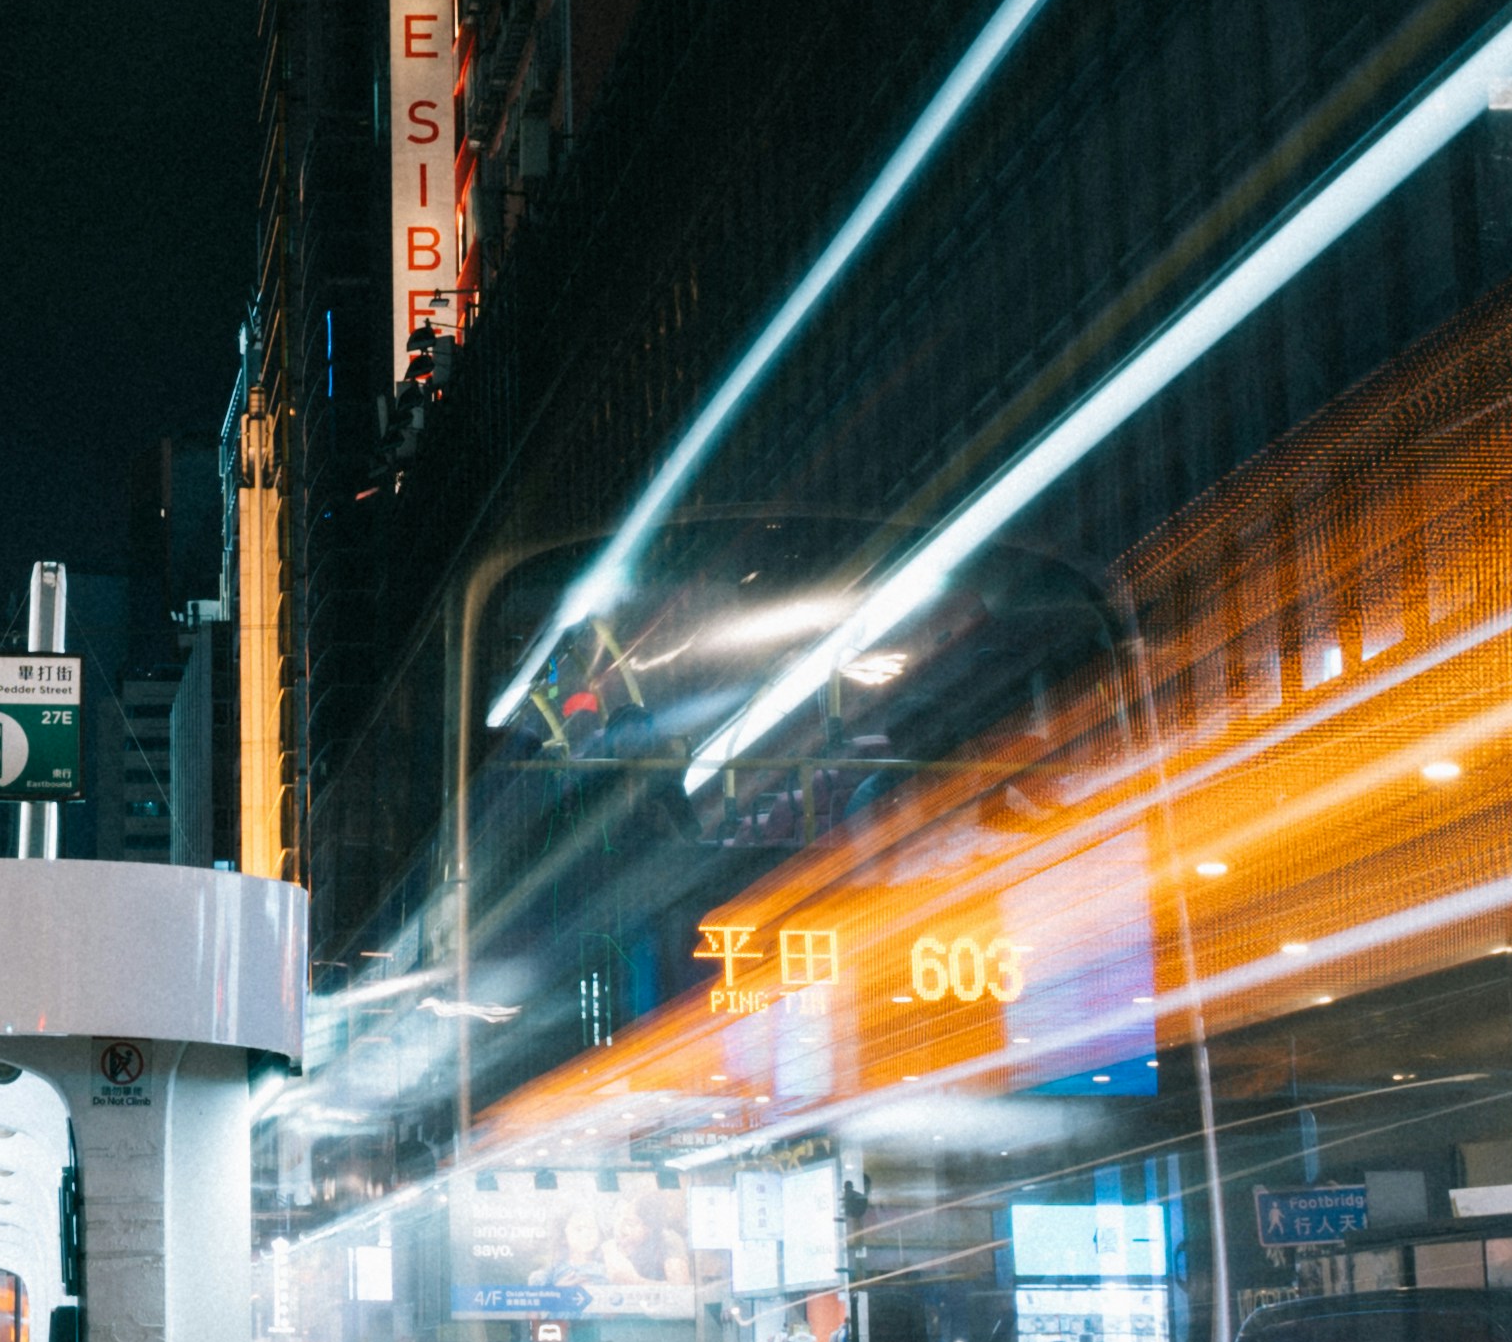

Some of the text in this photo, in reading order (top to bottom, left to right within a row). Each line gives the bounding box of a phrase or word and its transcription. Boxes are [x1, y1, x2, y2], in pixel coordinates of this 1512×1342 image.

[404, 99, 444, 381] SIBE
[18, 665, 72, 682] 畢打街
[39, 685, 73, 695] Street
[41, 711, 73, 725] 27E
[26, 780, 73, 789] Eastbound
[693, 925, 840, 987] 平田
[911, 937, 1024, 1002] 603
[710, 990, 770, 1014] PING
[92, 1096, 152, 1106] Do Not Climb
[1289, 1194, 1368, 1210] Footbridg
[472, 1244, 514, 1260] sayo.
[474, 1290, 503, 1307] 4/F
